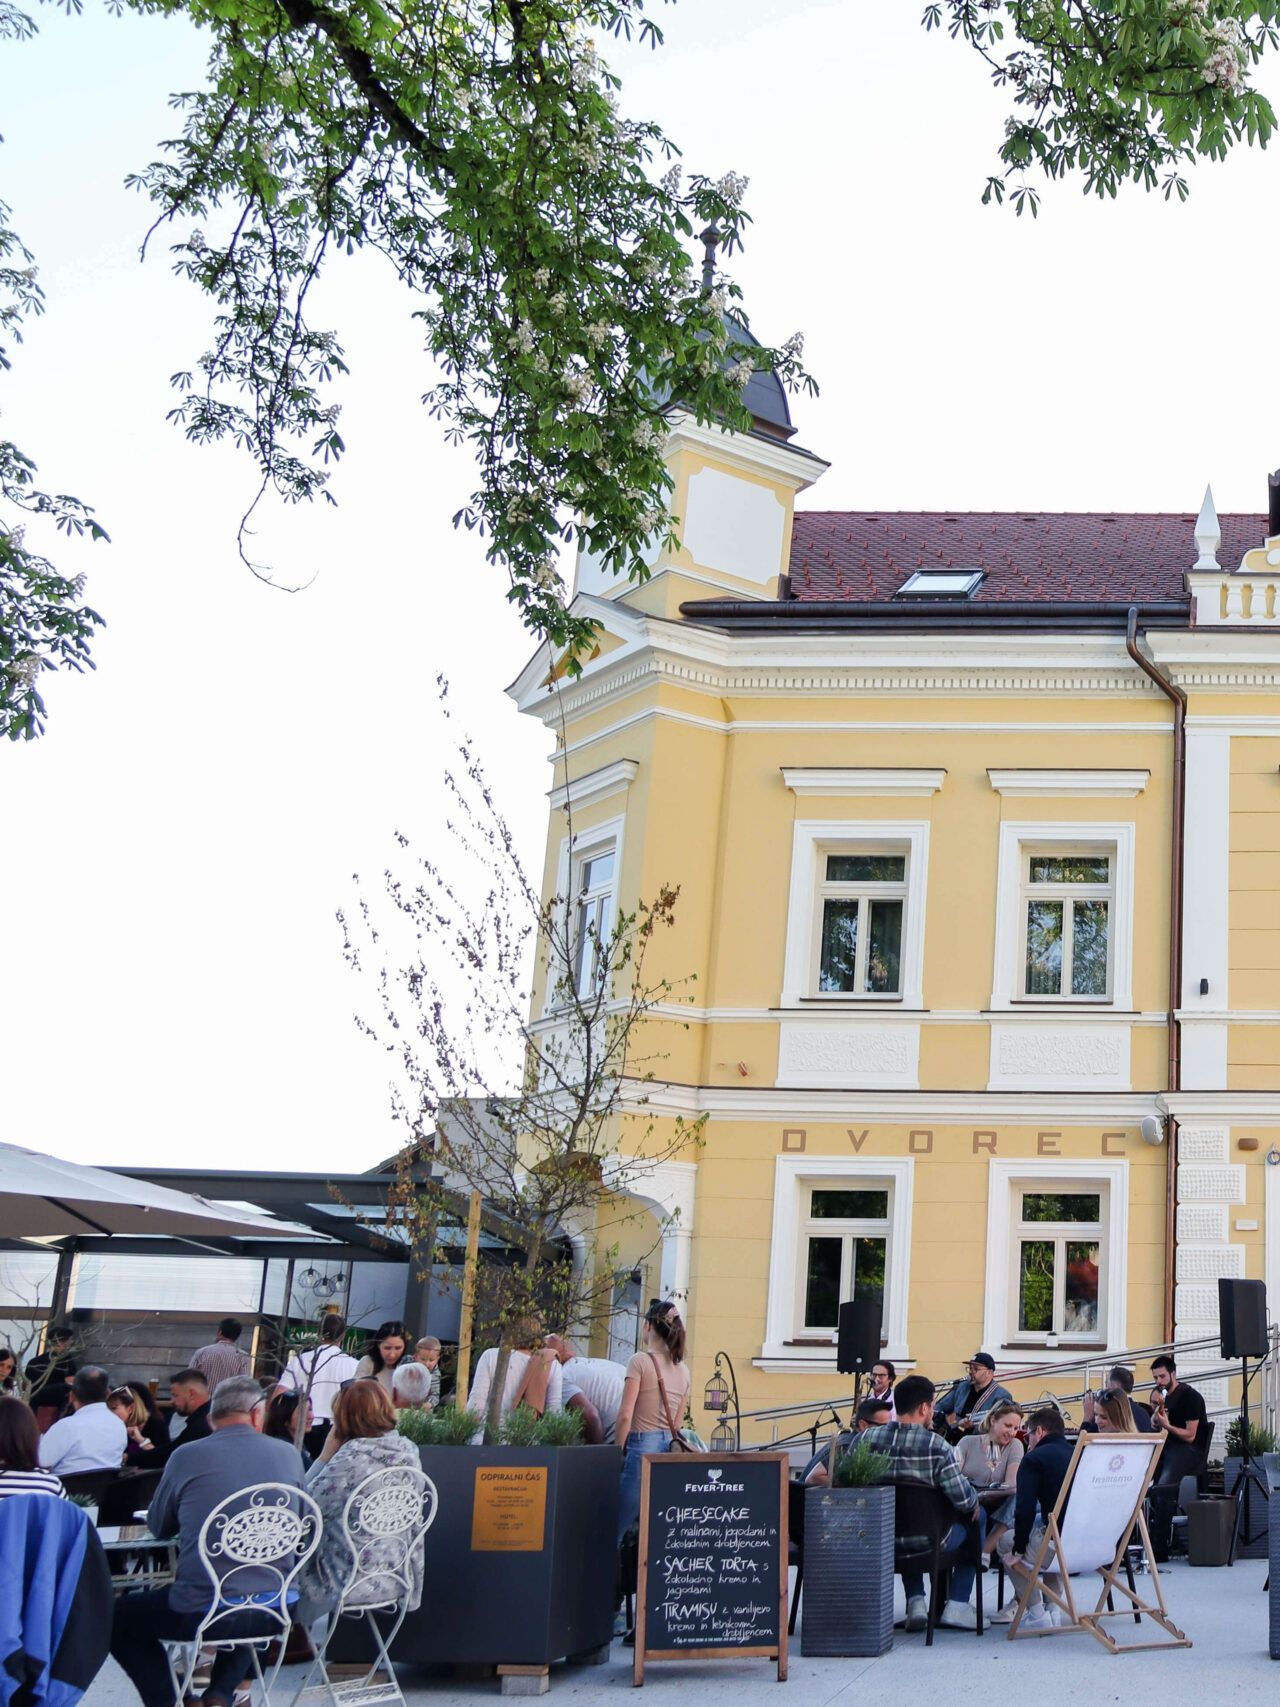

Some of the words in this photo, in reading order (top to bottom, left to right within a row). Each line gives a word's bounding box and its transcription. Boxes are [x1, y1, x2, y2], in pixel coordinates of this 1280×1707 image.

[781, 1128, 1127, 1157] DVOREC
[480, 1472, 523, 1481] ODPIRALNI
[525, 1471, 542, 1481] ČAS
[684, 1483, 745, 1493] FEVER-TREE
[665, 1506, 751, 1524] CHEESECAKE
[680, 1523, 723, 1538] malinami,
[724, 1523, 767, 1542] jagodami
[769, 1525, 777, 1535] in
[662, 1555, 716, 1576] SACHER
[720, 1556, 759, 1572] TORTA
[718, 1573, 748, 1584] kremo
[752, 1574, 762, 1584] in
[665, 1583, 712, 1600] jagodami
[661, 1602, 718, 1620] TIRAMISU
[667, 1620, 695, 1632] kremo
[700, 1623, 708, 1631] in
